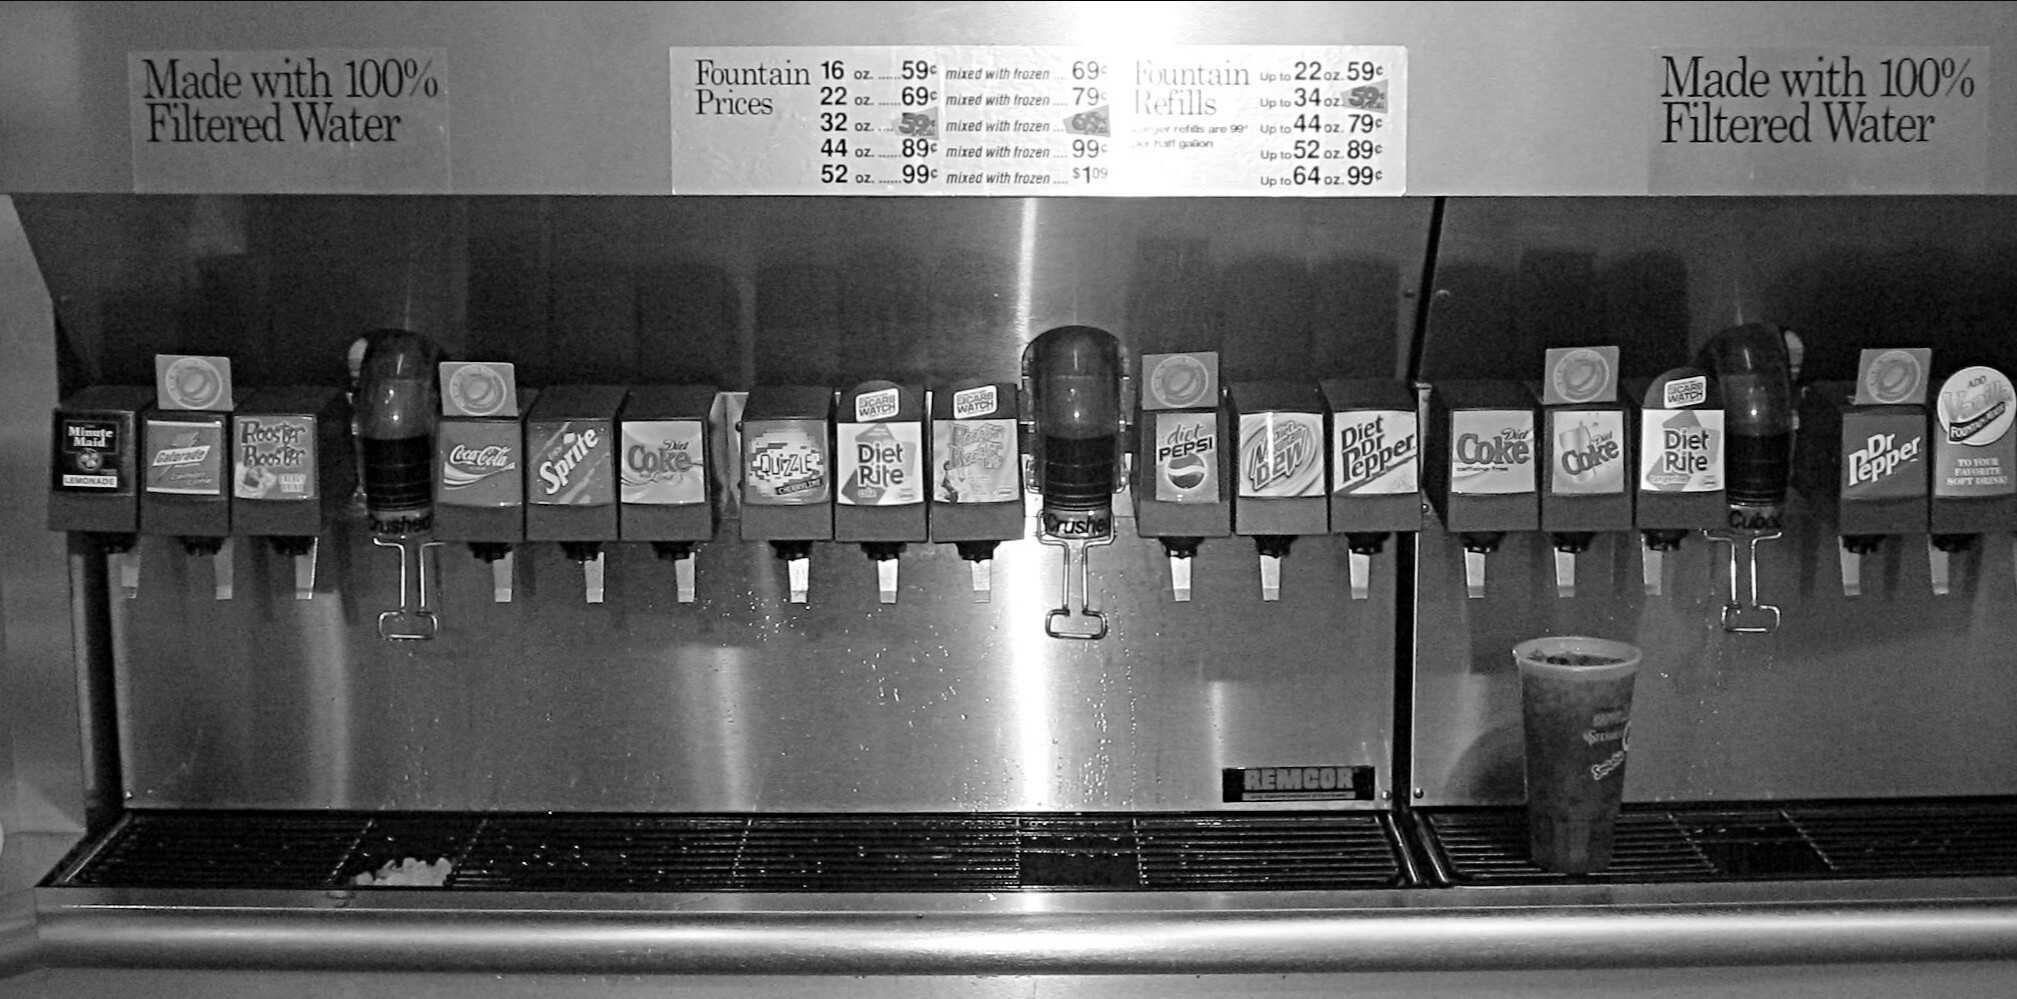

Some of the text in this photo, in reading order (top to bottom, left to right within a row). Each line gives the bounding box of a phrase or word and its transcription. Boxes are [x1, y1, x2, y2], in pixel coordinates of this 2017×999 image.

[142, 57, 438, 99] Made with 100%
[695, 59, 811, 86] Fountain
[821, 60, 844, 80] 16
[945, 68, 982, 80] mixed
[985, 68, 1010, 80] with
[1013, 68, 1050, 80] frozen
[1136, 60, 1250, 86] Fountain
[1260, 72, 1276, 82] Up
[1280, 72, 1291, 81] to
[1294, 61, 1322, 80] 22
[1661, 56, 1975, 98] Made with 100%
[695, 89, 774, 116] Prices
[820, 86, 848, 105] 22
[945, 94, 982, 106] mixed
[985, 94, 1010, 106] with
[1013, 94, 1050, 106] frozen
[1135, 89, 1217, 115] Refills
[1260, 98, 1276, 108] Up
[1280, 98, 1291, 107] to
[1294, 88, 1321, 107] 34
[146, 102, 401, 142] Filtered Water
[820, 112, 848, 132] 32
[945, 120, 982, 132] mixed
[985, 120, 1010, 132] with
[1013, 120, 1050, 132] frozen
[1208, 126, 1228, 134] are
[1260, 124, 1276, 135] Up
[1280, 124, 1292, 134] to
[1293, 114, 1321, 132] 44
[1662, 101, 1936, 143] Filtered Water
[820, 138, 848, 157] 44
[945, 146, 982, 158] mixed
[985, 146, 1010, 158] with
[1013, 146, 1050, 158] frozen
[1260, 150, 1277, 160] Up
[1280, 150, 1292, 160] to
[1294, 140, 1320, 159] 52
[821, 164, 848, 183] 52
[945, 172, 982, 184] mixed
[985, 172, 1010, 184] with
[1013, 172, 1050, 184] frozen
[1260, 176, 1277, 187] Up
[1280, 176, 1292, 186] to
[1293, 166, 1321, 185] 64
[957, 400, 994, 414] WATCH
[1668, 391, 1703, 403] WATCH
[859, 403, 896, 417] WATCH
[68, 426, 113, 437] Minute
[73, 437, 106, 447] Maid
[240, 420, 306, 444] Rooster
[1167, 424, 1205, 444] diet
[1341, 415, 1384, 451] Diet
[1501, 427, 1529, 440] Diet
[1664, 429, 1709, 450] Diet
[858, 443, 903, 463] Diet
[1159, 437, 1213, 461] PEPSI
[1361, 433, 1385, 457] Dr
[1457, 433, 1531, 464] Coke
[1867, 434, 1895, 459] Dr
[540, 429, 599, 495] Sprite
[628, 444, 692, 473] Coke
[1256, 439, 1304, 490] DEW
[1342, 433, 1415, 482] Pepper
[1562, 441, 1620, 475] Coke
[1664, 451, 1708, 474] Rite
[1848, 435, 1921, 486] Pepper
[1957, 458, 1999, 467] TO YOUR
[65, 476, 115, 486] LEMONADE
[859, 465, 904, 487] Rite
[1946, 477, 1973, 486] SOFT
[1954, 467, 2001, 477] FAVORITE
[1045, 513, 1107, 535] Crushe
[1244, 767, 1354, 791] REMCOR
